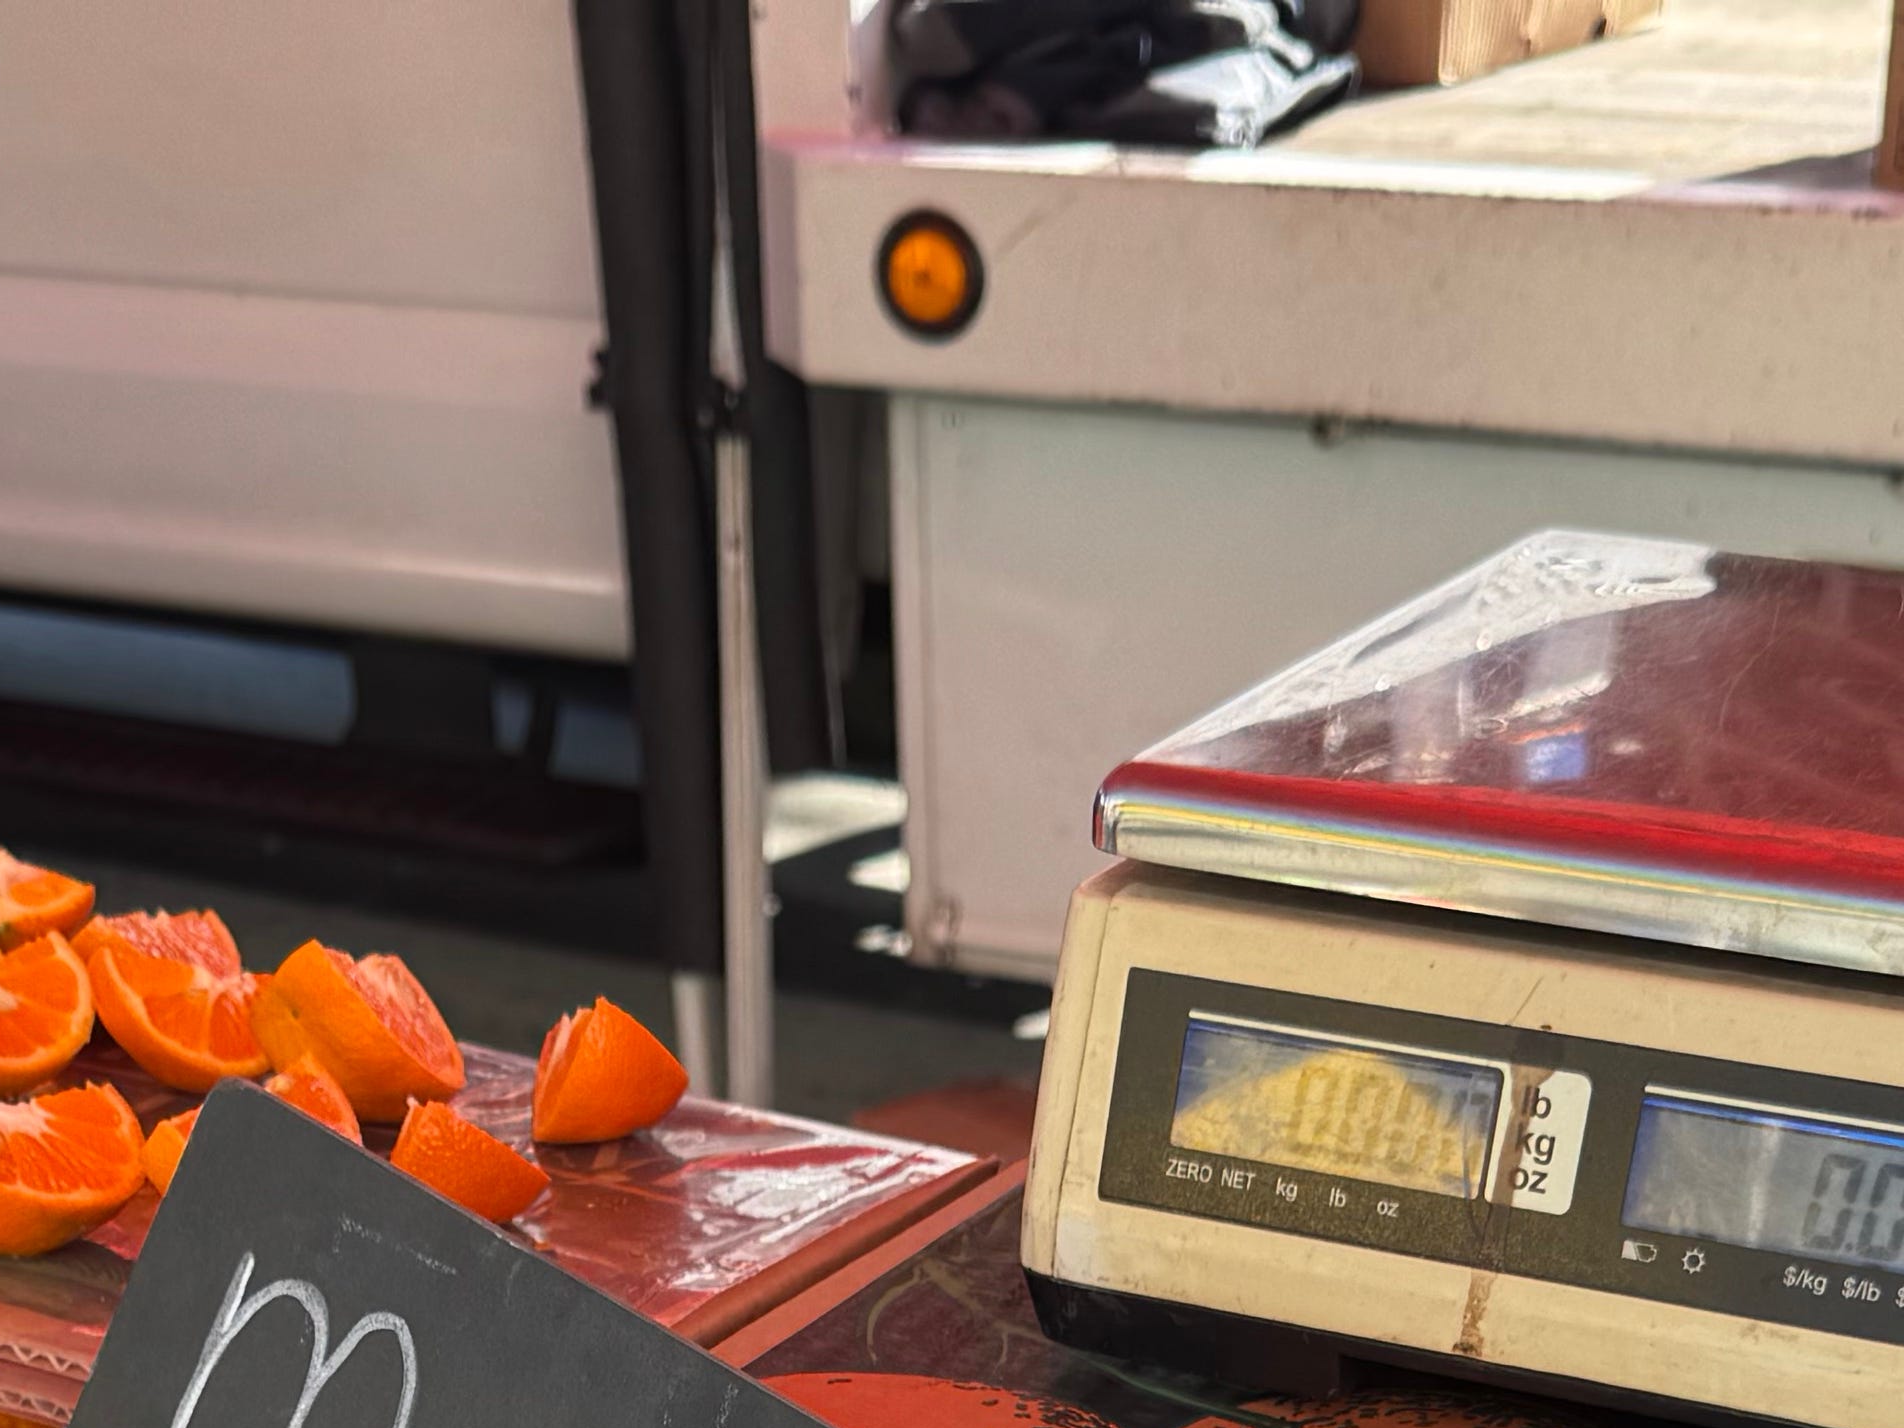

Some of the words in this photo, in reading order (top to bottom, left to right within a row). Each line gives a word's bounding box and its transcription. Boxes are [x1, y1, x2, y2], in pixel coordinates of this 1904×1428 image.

[1522, 1085, 1552, 1120] lb
[1516, 1122, 1557, 1168] kg
[1166, 1158, 1213, 1185] ZERO
[1220, 1167, 1256, 1192] NET
[1275, 1176, 1298, 1203] kg
[1329, 1186, 1346, 1209] lb
[1376, 1199, 1400, 1218] oz
[1511, 1166, 1548, 1196] oz
[1782, 1265, 1828, 1297] $/kg
[1841, 1275, 1881, 1303] $/lb
